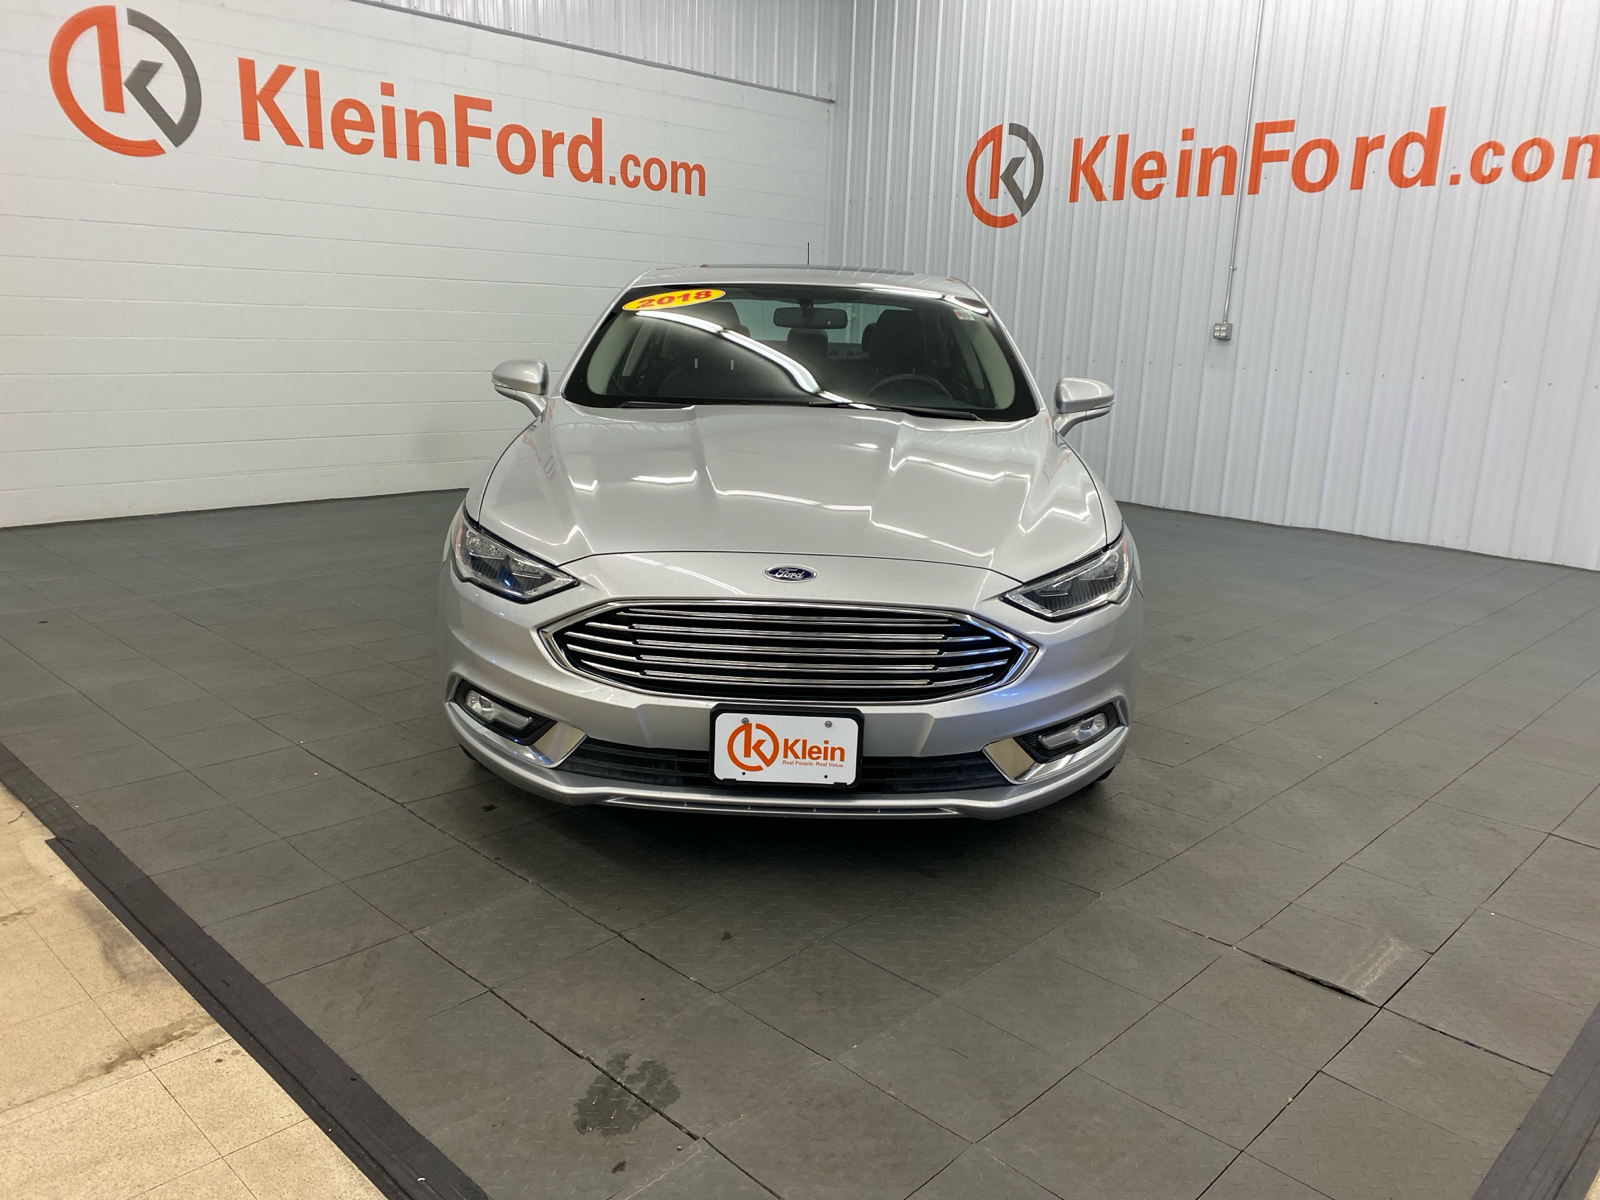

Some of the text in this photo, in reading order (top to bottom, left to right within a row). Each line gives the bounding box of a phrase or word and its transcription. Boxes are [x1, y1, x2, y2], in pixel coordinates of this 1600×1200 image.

[238, 57, 707, 197] KleinFord.com
[636, 290, 712, 309] 2018
[774, 568, 805, 579] Ford
[782, 738, 845, 762] Klein
